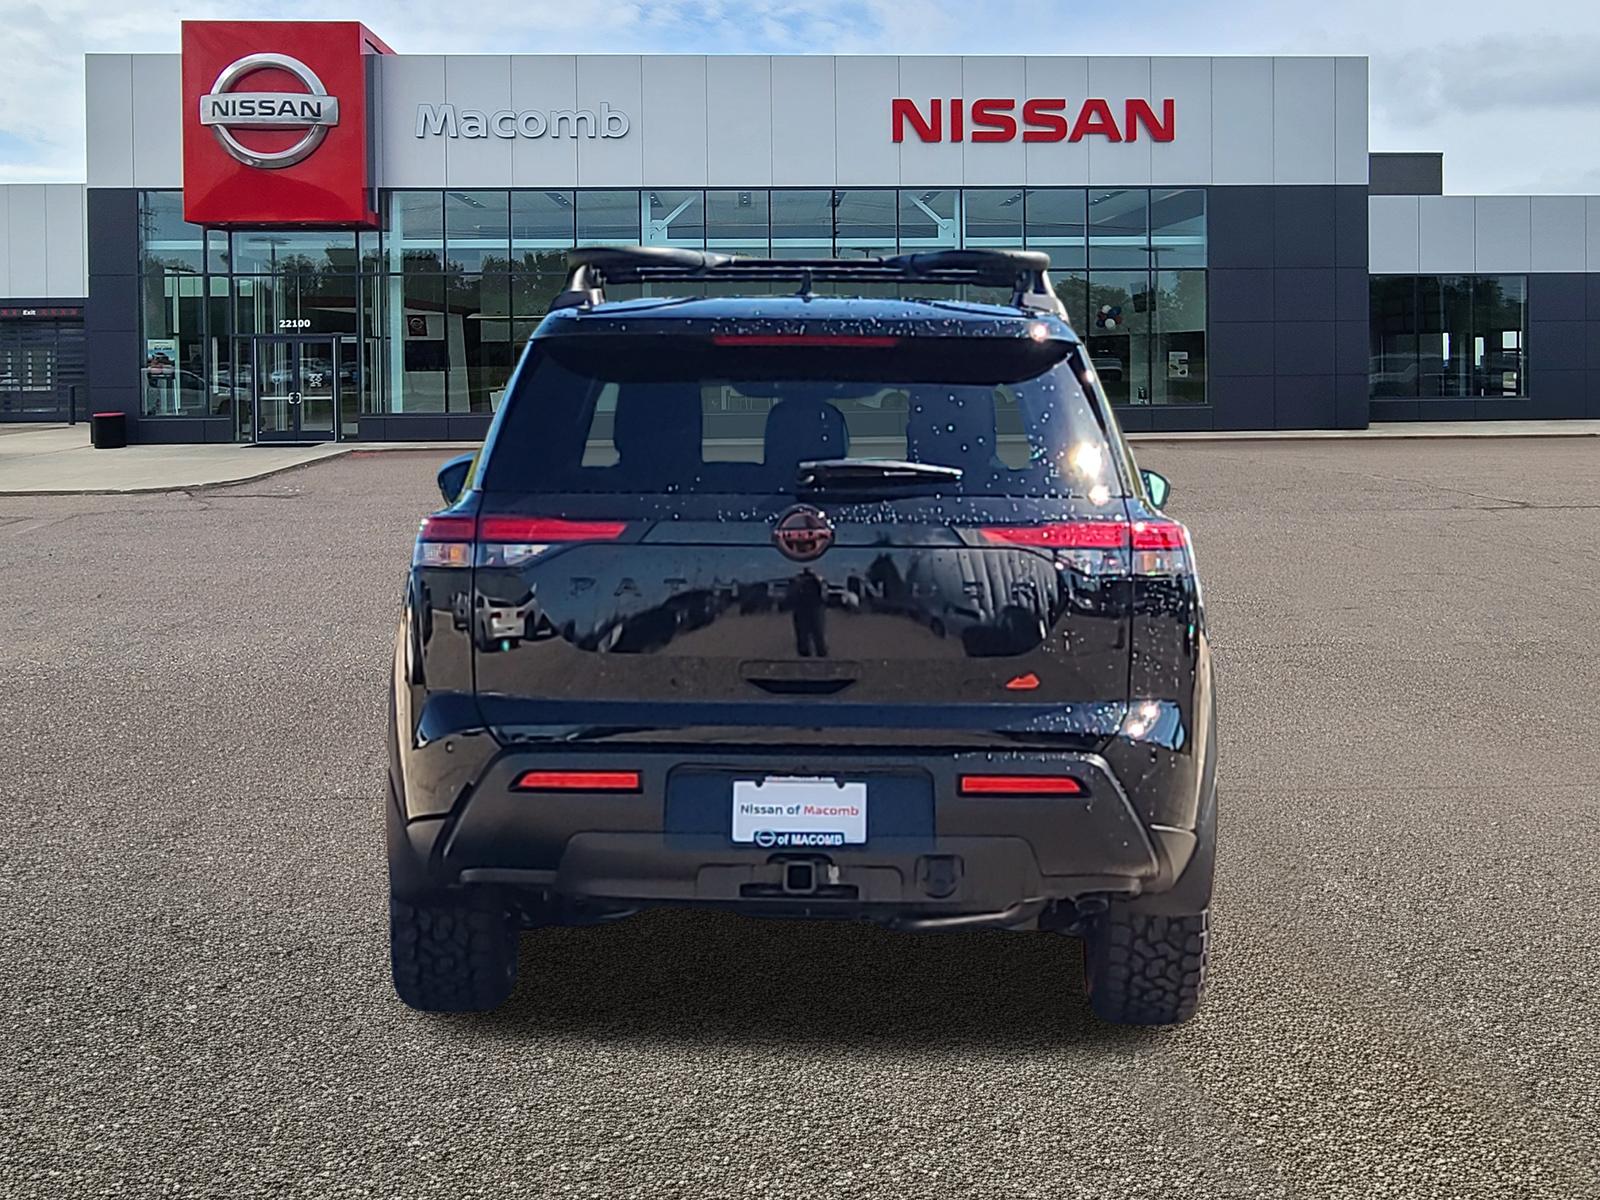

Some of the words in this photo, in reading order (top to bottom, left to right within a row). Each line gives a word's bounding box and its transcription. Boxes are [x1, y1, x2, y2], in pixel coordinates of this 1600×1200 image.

[212, 99, 321, 117] NISSAN
[416, 102, 630, 138] Macomb
[892, 98, 1175, 143] NISSAN
[279, 319, 311, 328] 22100
[740, 804, 783, 815] Nissan
[786, 804, 800, 815] of
[803, 806, 859, 816] Macomb
[777, 834, 789, 845] of
[791, 834, 843, 845] MACOMB
